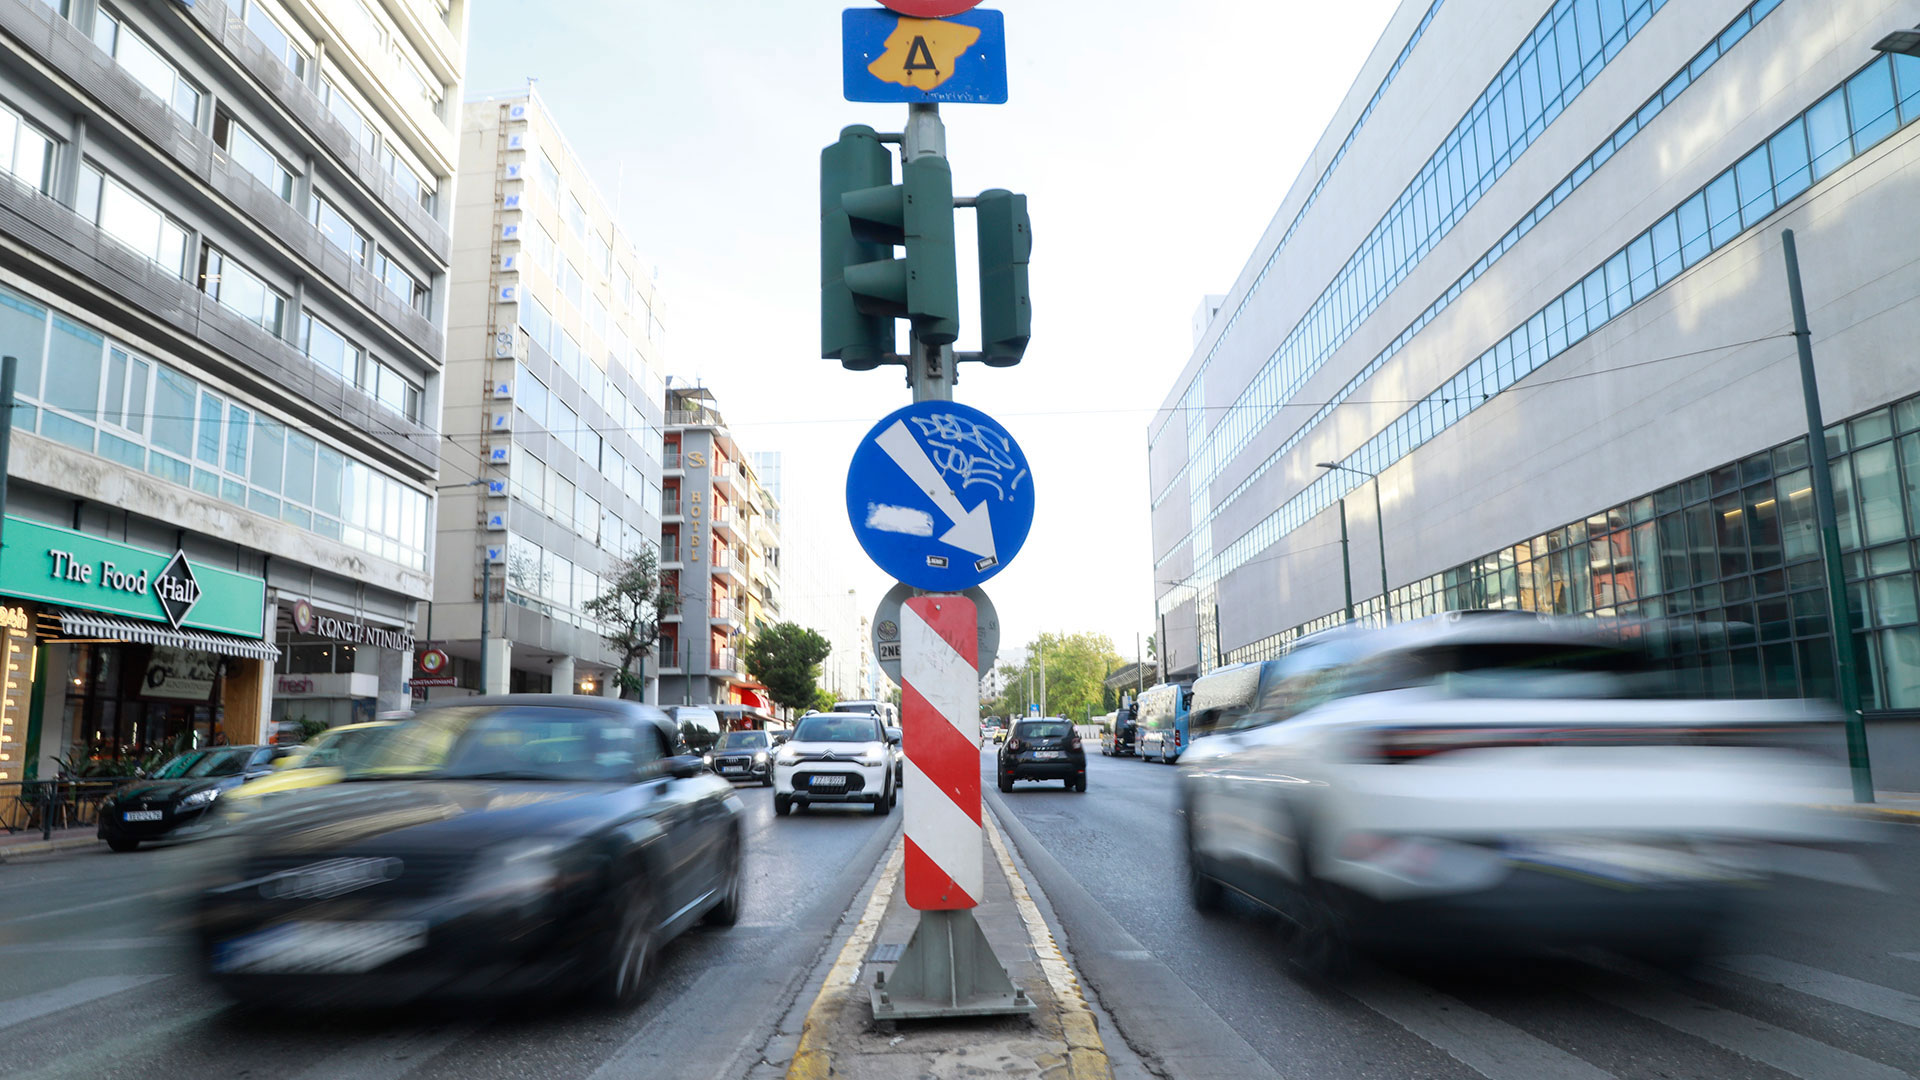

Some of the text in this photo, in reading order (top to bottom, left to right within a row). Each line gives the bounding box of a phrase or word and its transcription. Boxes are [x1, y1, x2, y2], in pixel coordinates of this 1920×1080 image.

[691, 491, 701, 561] HOTEL
[49, 549, 195, 603] The Food Hall
[278, 676, 314, 694] fresh
